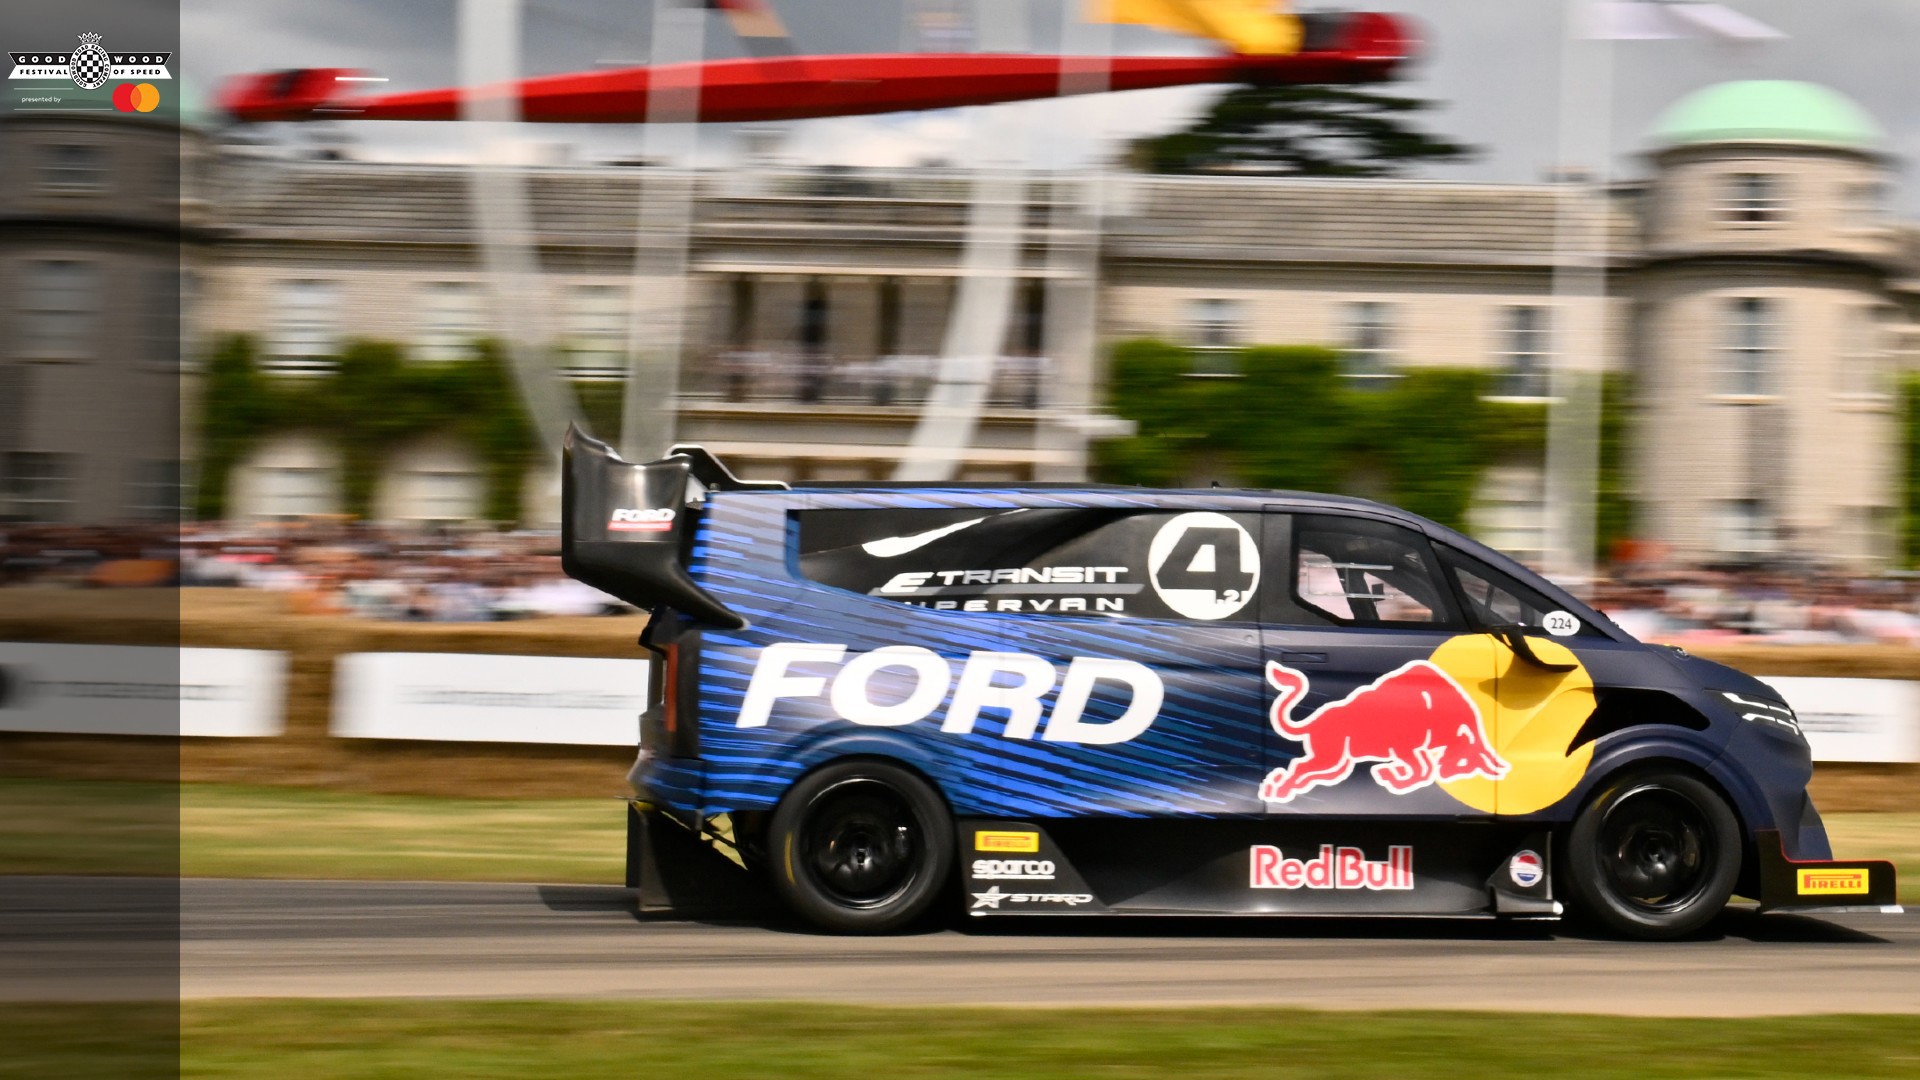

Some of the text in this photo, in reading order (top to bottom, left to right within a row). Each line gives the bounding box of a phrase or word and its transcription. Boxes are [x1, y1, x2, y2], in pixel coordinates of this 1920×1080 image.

[936, 567, 1128, 586] TRANSIT
[904, 598, 1124, 611] PERVAN
[1551, 617, 1572, 630] 224
[736, 642, 1165, 745] FORD
[971, 859, 1056, 880] sparco
[1250, 844, 1414, 889] Red Bull
[1803, 874, 1862, 889] PIRELLI
[1009, 893, 1094, 906] STARD
